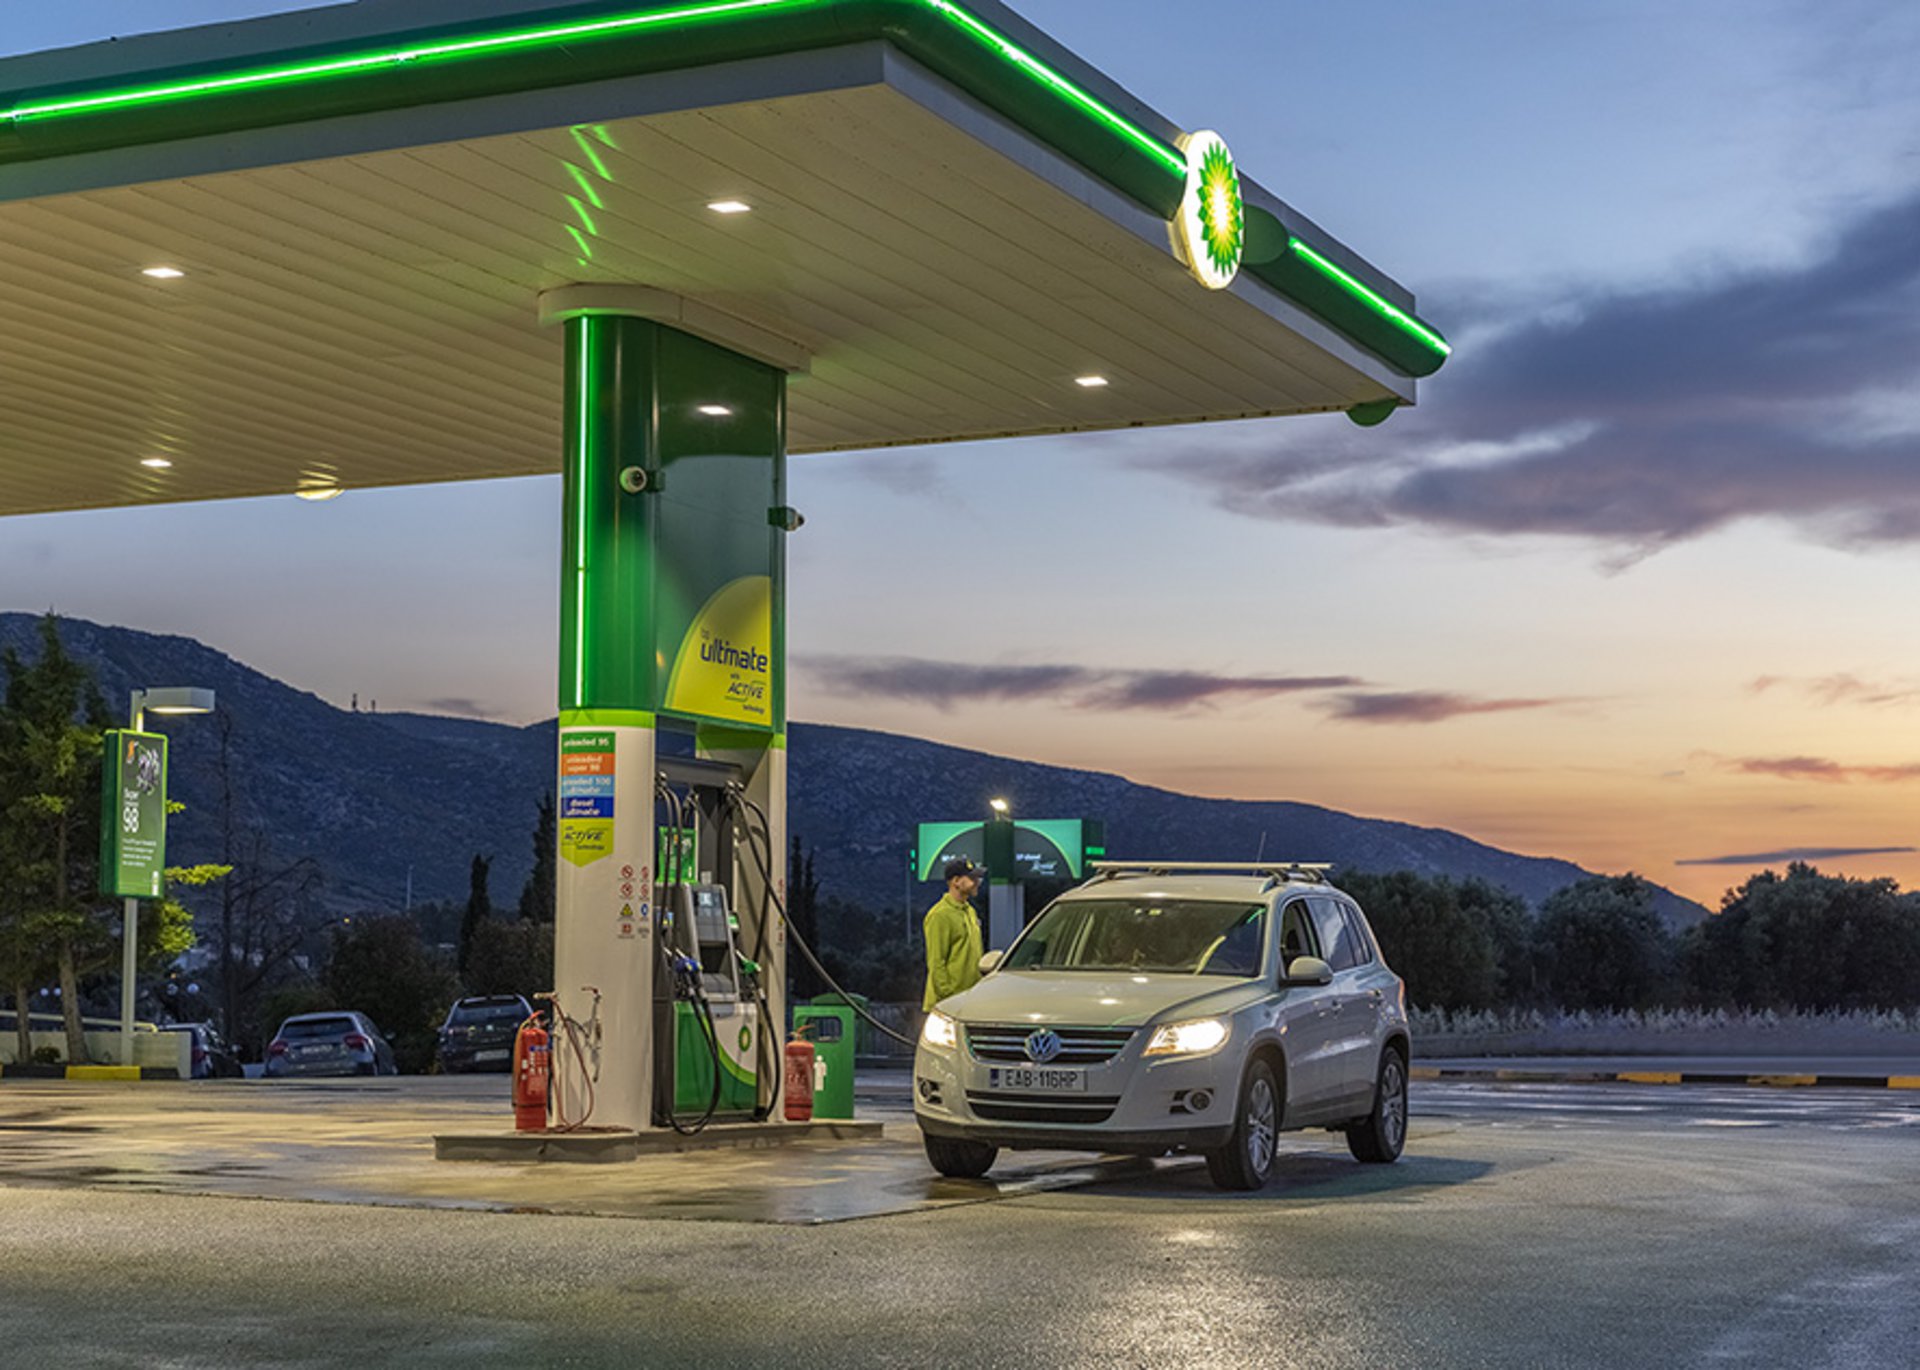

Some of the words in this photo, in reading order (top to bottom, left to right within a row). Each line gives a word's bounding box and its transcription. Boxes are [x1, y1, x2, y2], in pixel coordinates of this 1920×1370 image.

[701, 639, 768, 673] ultimate
[728, 682, 764, 699] ACTIVE
[564, 831, 604, 842] ACTIVE
